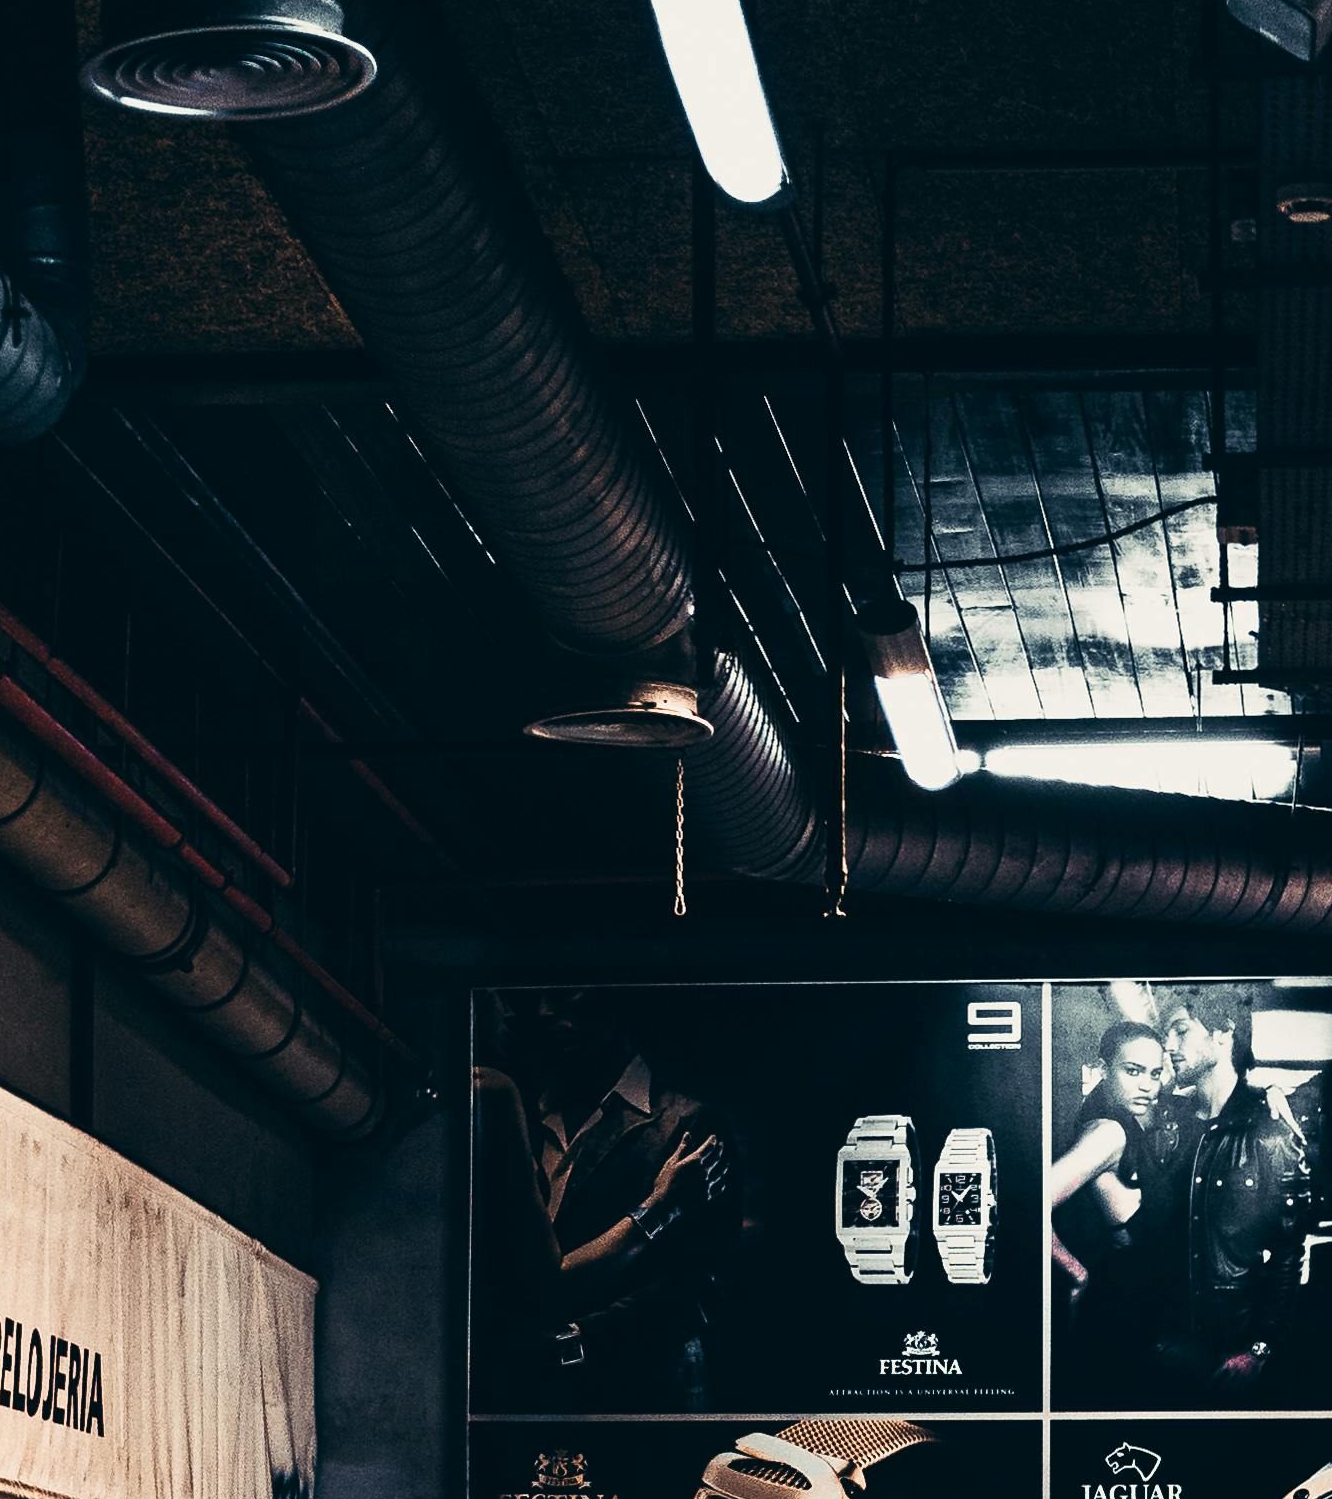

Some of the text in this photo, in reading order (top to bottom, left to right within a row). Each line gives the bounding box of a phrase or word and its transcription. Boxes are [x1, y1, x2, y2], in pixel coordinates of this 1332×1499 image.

[967, 1002, 1021, 1042] 9
[879, 1359, 963, 1375] FESTINA
[917, 1388, 969, 1396] UNIVERSAL
[974, 1388, 1015, 1396] FEELING
